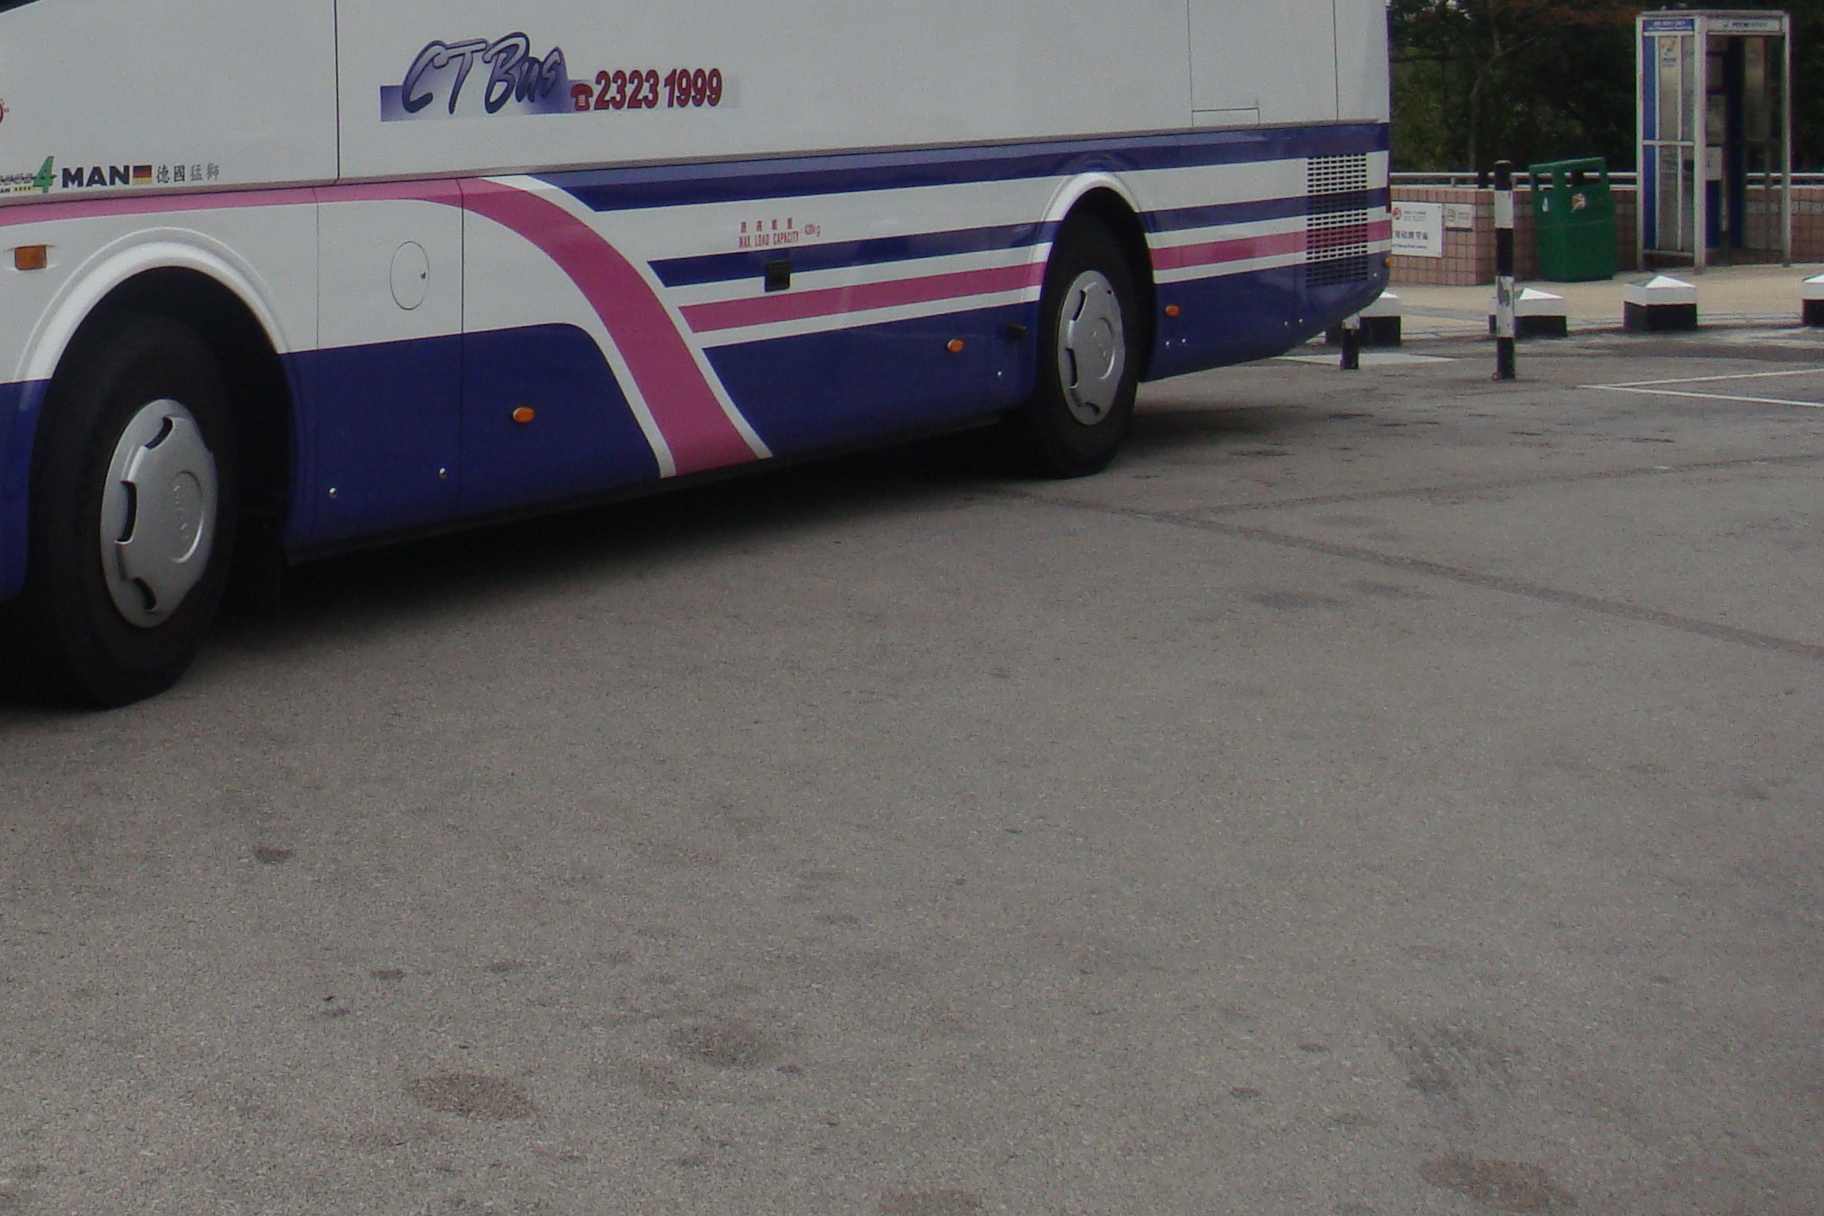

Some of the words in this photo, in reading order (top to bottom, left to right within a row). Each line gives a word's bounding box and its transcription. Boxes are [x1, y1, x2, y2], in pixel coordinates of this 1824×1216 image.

[594, 69, 659, 110] 2323
[664, 68, 723, 108] 1999
[61, 164, 130, 189] MAN
